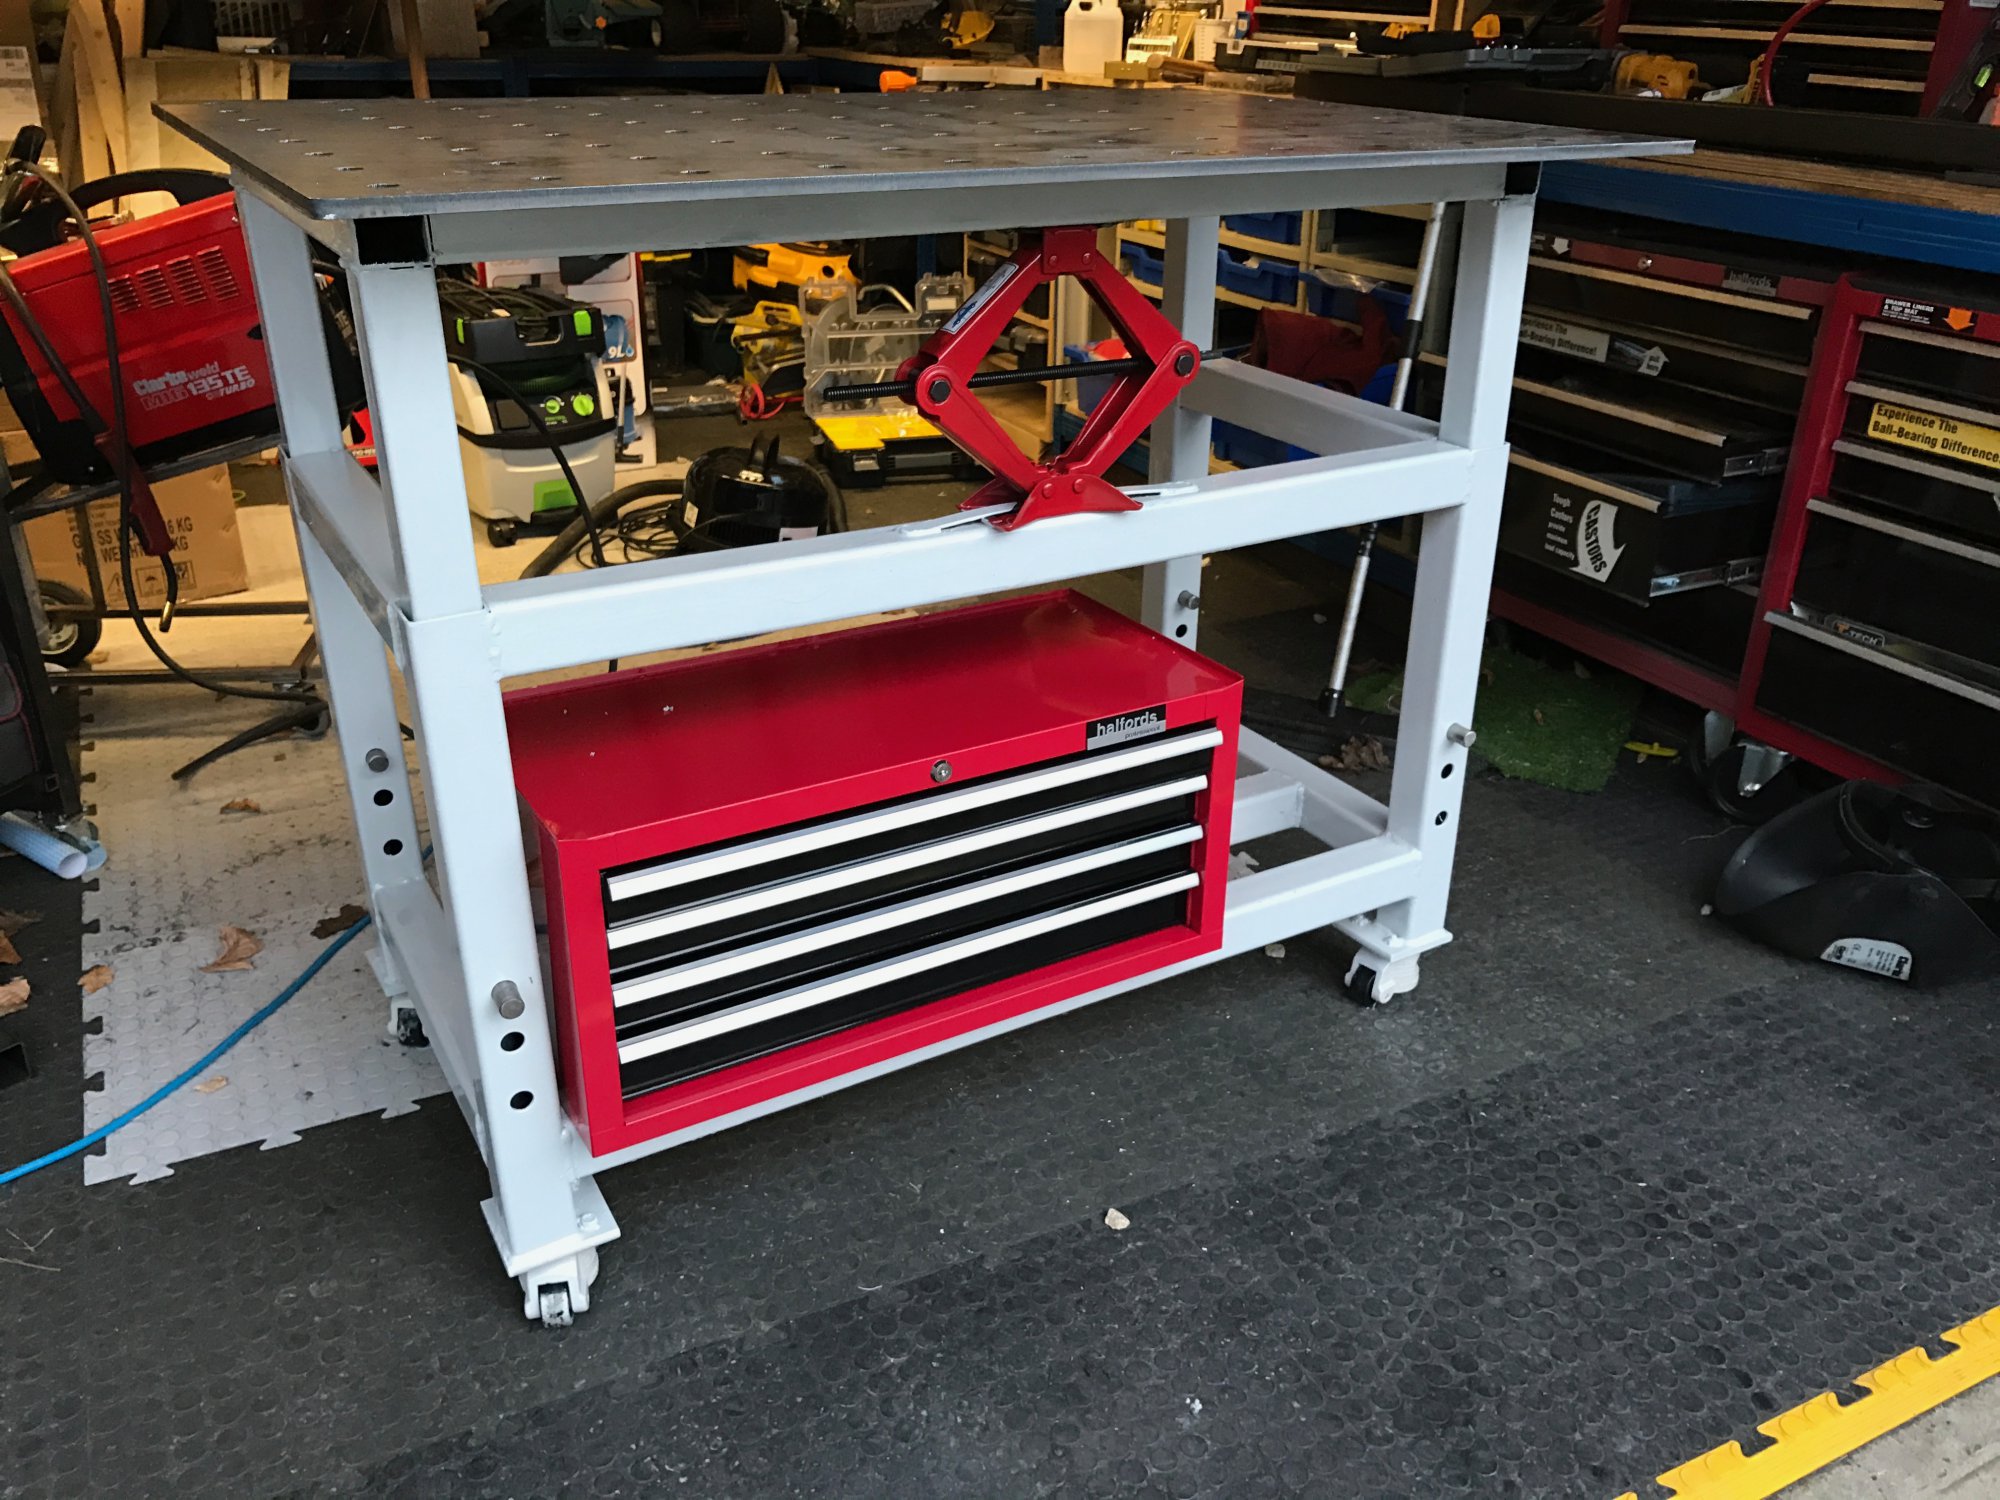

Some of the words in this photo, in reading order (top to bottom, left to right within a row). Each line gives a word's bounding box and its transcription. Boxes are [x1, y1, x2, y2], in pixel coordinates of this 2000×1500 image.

[1729, 270, 1772, 289] halfords
[1885, 298, 1911, 308] DRAWER
[1912, 303, 1934, 313] LINERS
[608, 346, 625, 359] 9L
[1876, 404, 1935, 429] Experience
[1938, 420, 1958, 434] The
[1872, 420, 1938, 449] Ball-Bearing
[1941, 437, 2000, 463] Difference
[1553, 493, 1571, 508] Tough
[176, 516, 193, 533] KG
[1585, 504, 1607, 573] CASTORS
[1097, 711, 1158, 737] halfords
